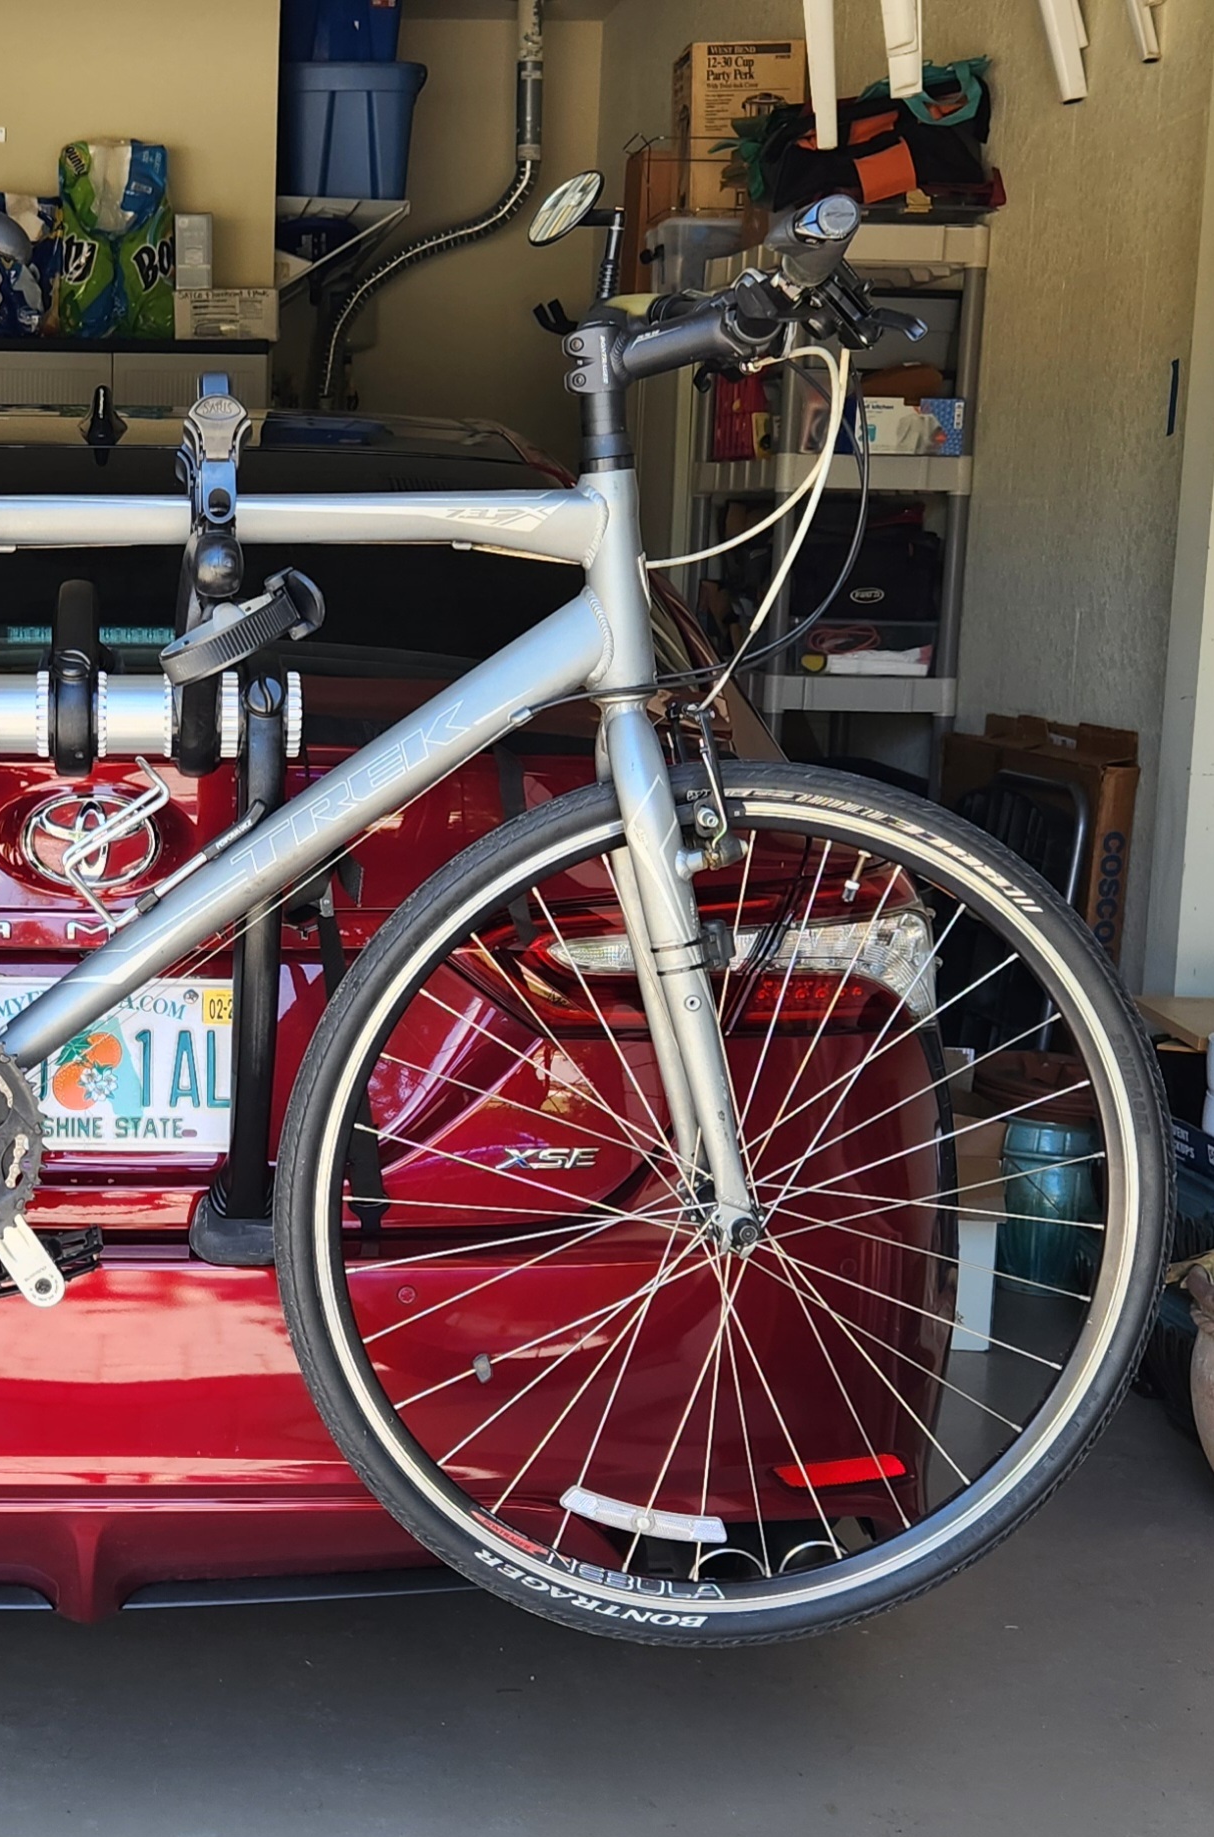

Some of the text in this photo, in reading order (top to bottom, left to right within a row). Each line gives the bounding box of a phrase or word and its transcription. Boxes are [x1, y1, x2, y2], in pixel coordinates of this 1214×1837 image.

[709, 46, 756, 54] WEST BEND
[707, 56, 754, 72] 12-30 Cup
[706, 69, 755, 83] Party Perk
[231, 700, 472, 882] TREK
[1094, 831, 1126, 943] COSCO
[42, 1118, 183, 1140] SHINE STATE
[495, 1147, 601, 1170] XSE
[546, 1549, 726, 1600] NEBULA
[474, 1548, 709, 1628] BONTRAGER
